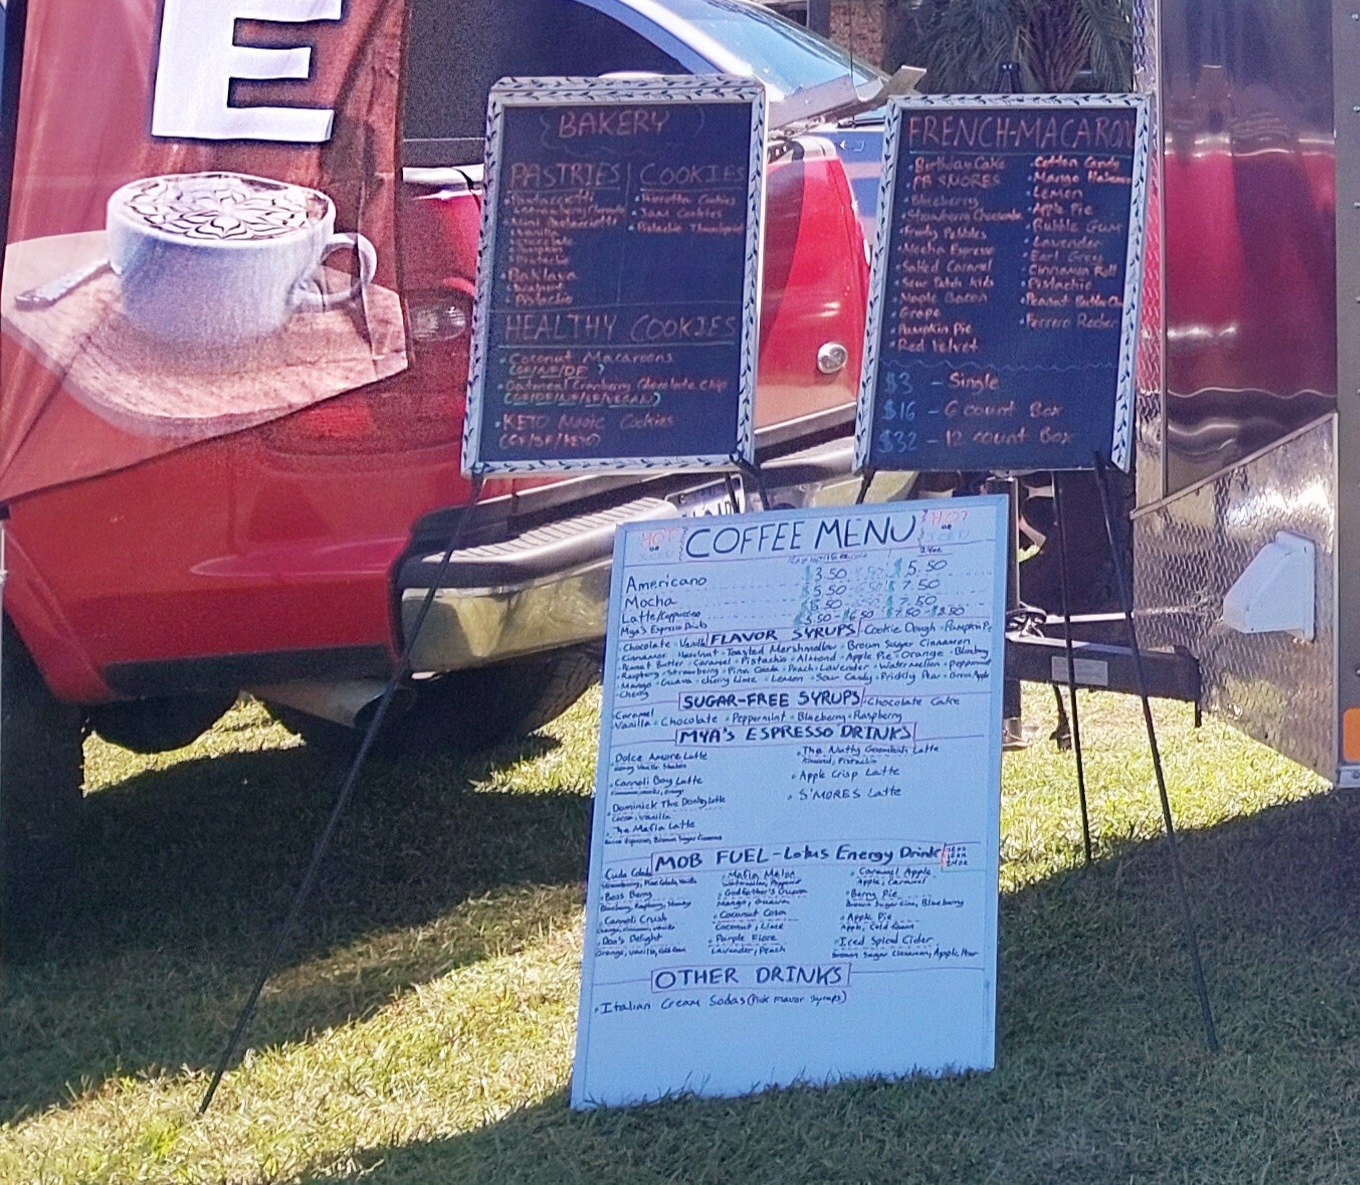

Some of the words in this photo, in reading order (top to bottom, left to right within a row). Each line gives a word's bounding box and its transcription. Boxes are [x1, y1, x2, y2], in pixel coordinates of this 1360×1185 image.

[558, 111, 670, 139] BAKERY
[511, 162, 620, 187] PASTRIES
[641, 162, 745, 185] COOKIES
[1033, 186, 1083, 199] Lemon
[1033, 202, 1064, 217] Apple
[1071, 202, 1094, 216] Pie
[1032, 217, 1079, 233] Bubble
[1086, 219, 1123, 233] Gum
[1032, 235, 1102, 249] Lavender
[1030, 249, 1059, 262] Earl
[902, 259, 940, 273] Salted
[1026, 291, 1069, 306] Peanut
[899, 306, 941, 320] Grape
[505, 315, 617, 340] HEALTHY
[630, 314, 737, 342] COOKIES
[953, 321, 973, 336] Pie
[897, 337, 925, 353] Red
[507, 350, 573, 365] Coconut
[582, 352, 674, 364] Macaroons
[885, 372, 913, 395] $3
[949, 371, 1000, 395] Single
[882, 400, 917, 421] $16
[963, 400, 1017, 417] count
[1029, 401, 1064, 418] Box
[503, 414, 549, 431] KETO
[879, 430, 918, 454] $32
[945, 431, 963, 447] 12
[973, 426, 1029, 444] count
[1039, 430, 1073, 445] Box
[685, 520, 806, 558] COFFEE
[814, 514, 917, 550] MENU
[625, 575, 708, 594] Americano
[624, 596, 677, 610] Mocha
[711, 629, 778, 646] FLAVOR
[793, 624, 856, 641] SYRUPS
[863, 622, 901, 635] Cookie
[905, 622, 937, 637] Dough
[622, 638, 671, 652] Chocolate
[727, 645, 765, 656] Toasted
[740, 654, 787, 664] Pistachio
[845, 653, 872, 663] Apple
[876, 649, 891, 661] Pie
[901, 650, 944, 660] Orange
[820, 661, 869, 672] Lavender
[733, 675, 758, 684] Lime
[844, 672, 873, 684] Candy
[682, 692, 790, 710] SUGAR-FREE
[797, 689, 861, 706] SYRUPS
[867, 697, 923, 707] Chocolate
[614, 718, 651, 730] Vanilla
[660, 714, 718, 727] Chocolate
[746, 724, 834, 742] ESPRESSO
[840, 724, 912, 741] DRINKS
[802, 745, 824, 755] The
[615, 752, 643, 764] Dolce
[675, 775, 704, 786] Latte
[799, 771, 826, 784] Apple
[831, 770, 858, 782] Crisp
[865, 767, 901, 777] Latte
[799, 788, 862, 801] S'MORES
[867, 787, 902, 798] Latte
[661, 798, 680, 808] The
[655, 853, 703, 872] MOB
[835, 844, 894, 866] Energy
[904, 866, 932, 878] Apple
[882, 889, 899, 899] Pie
[877, 912, 893, 921] Pie
[902, 934, 935, 945] Cider
[654, 967, 740, 990] OTHER
[755, 966, 843, 986] DRINKS
[601, 999, 652, 1015] Italian
[660, 996, 701, 1011] Cream
